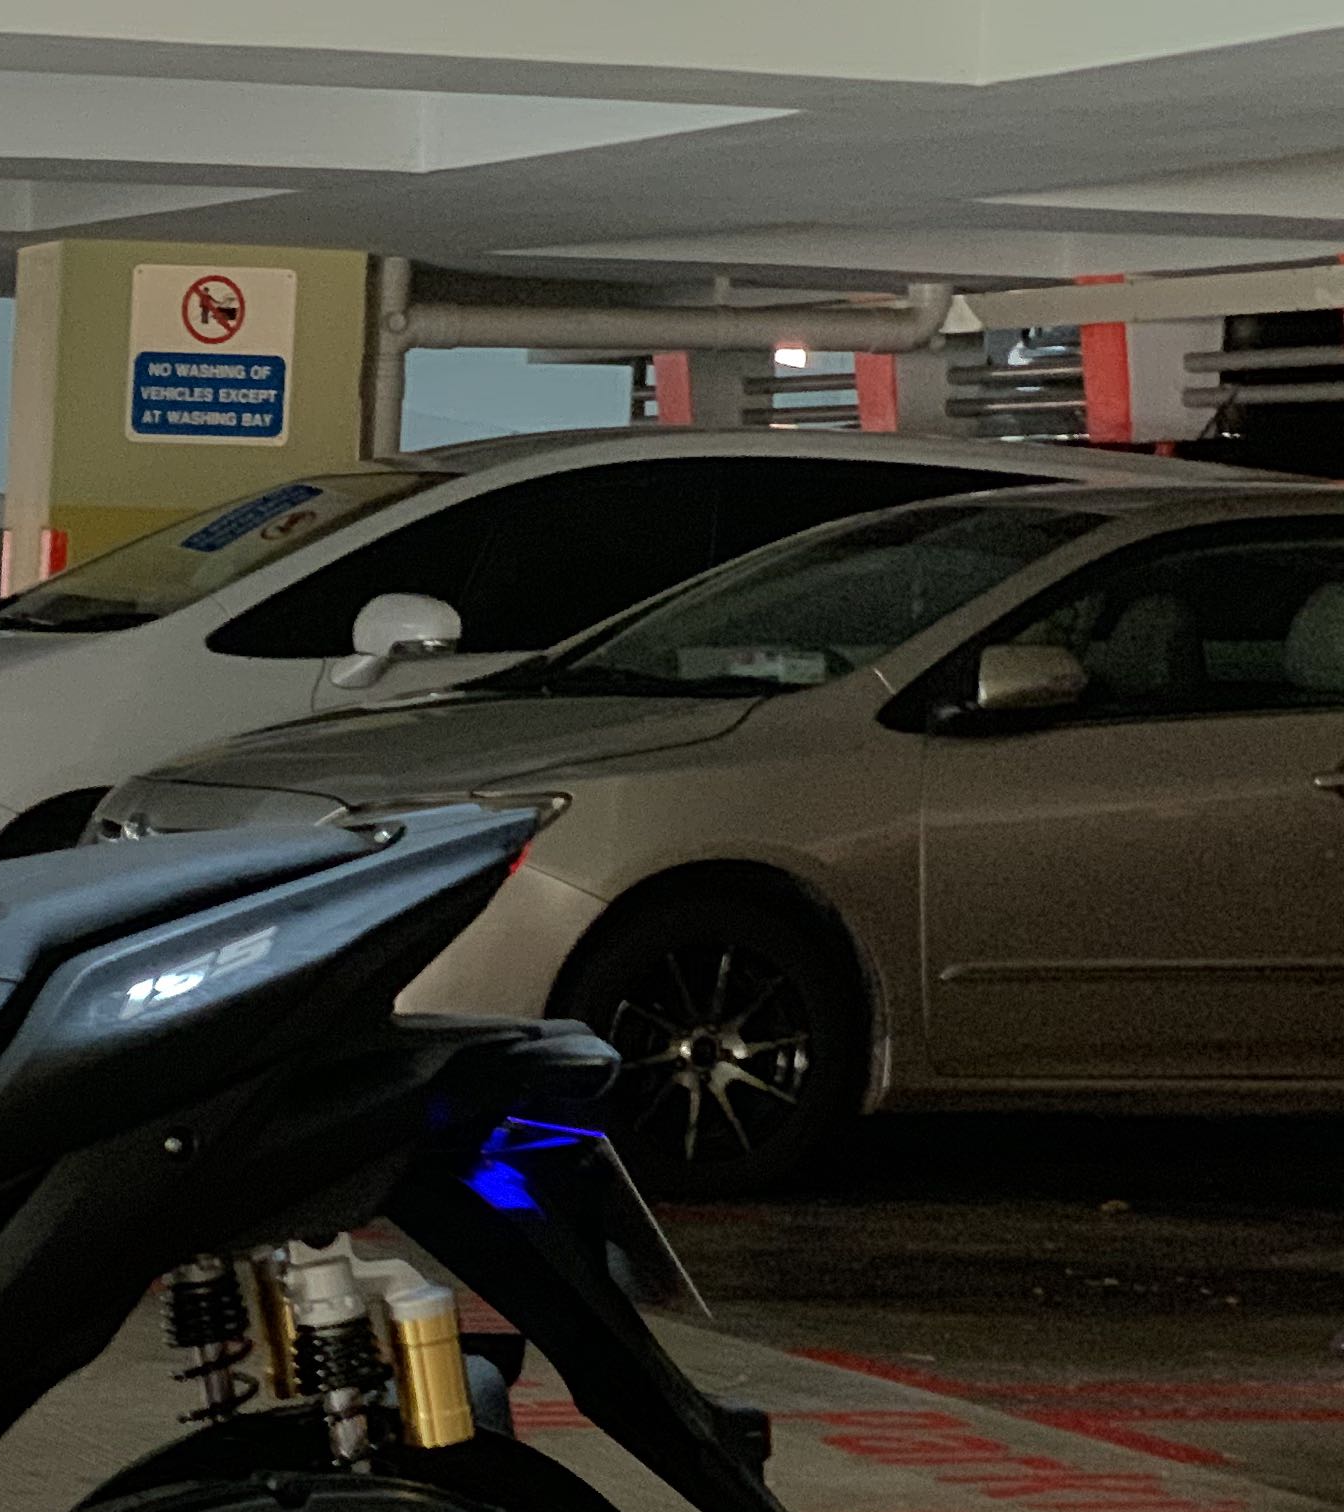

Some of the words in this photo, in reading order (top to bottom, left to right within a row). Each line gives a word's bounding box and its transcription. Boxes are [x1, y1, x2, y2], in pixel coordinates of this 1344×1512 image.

[148, 362, 172, 377] NO
[175, 363, 246, 379] WASHING
[250, 366, 272, 380] OF
[140, 386, 213, 402] VEHICLES
[219, 388, 278, 403] EXCEPT
[140, 410, 162, 424] AT
[167, 410, 238, 426] WASHING
[242, 412, 274, 427] BAY
